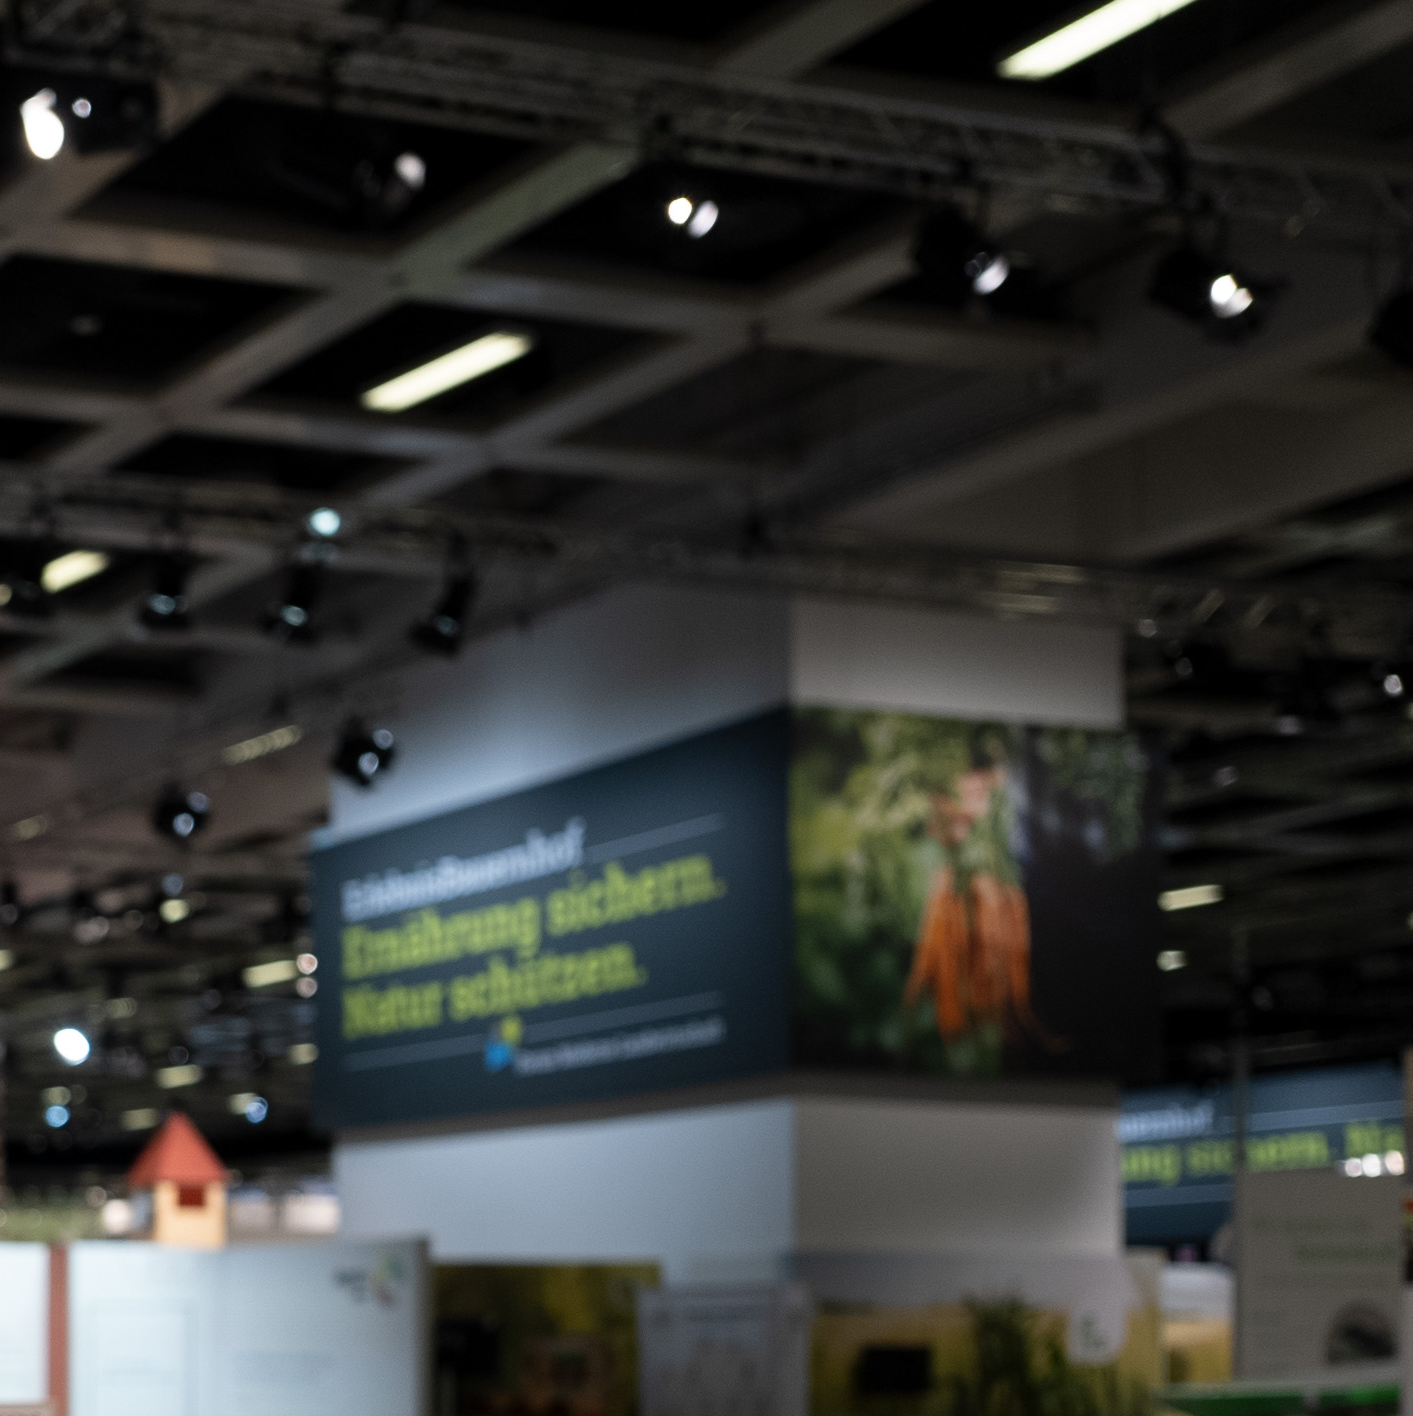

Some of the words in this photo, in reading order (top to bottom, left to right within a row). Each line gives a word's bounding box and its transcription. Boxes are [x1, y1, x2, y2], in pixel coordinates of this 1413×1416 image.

[342, 900, 539, 978] Ernährung
[548, 856, 725, 935] sichern.
[342, 983, 444, 1039] Natur
[449, 944, 647, 1019] schützen.
